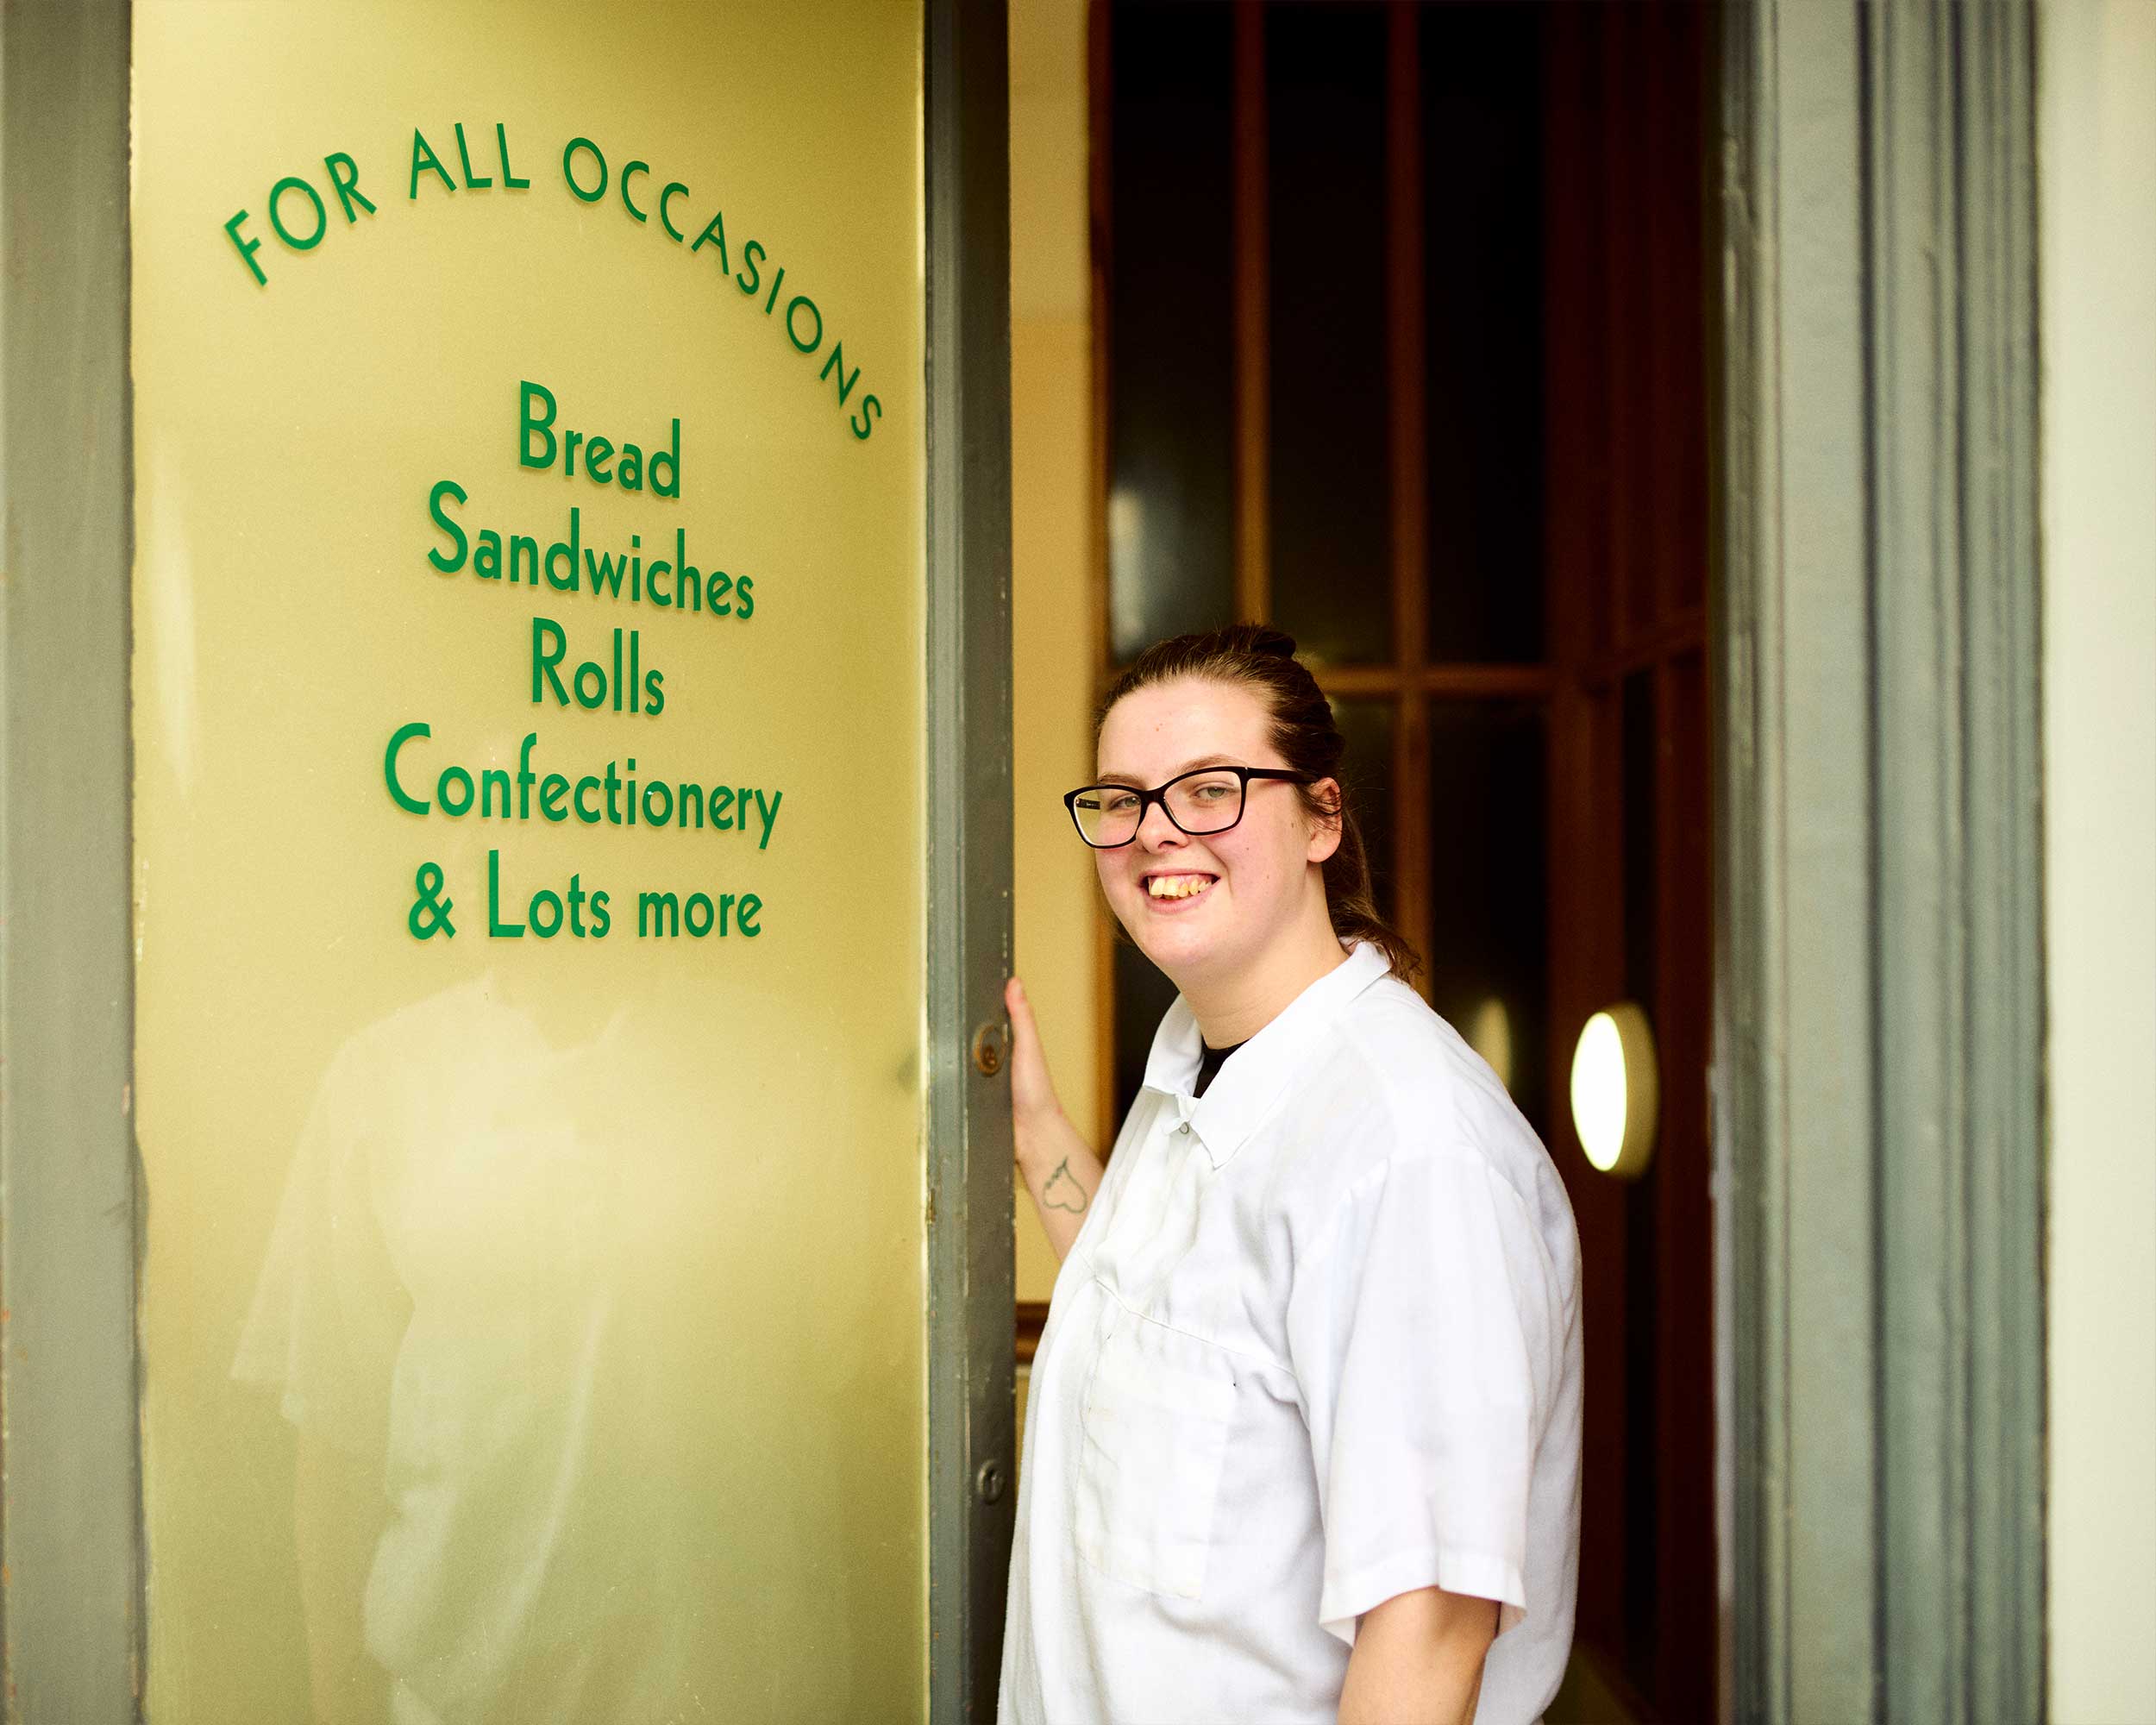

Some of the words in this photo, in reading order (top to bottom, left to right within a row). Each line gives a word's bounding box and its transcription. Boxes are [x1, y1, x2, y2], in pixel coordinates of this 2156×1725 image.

[223, 151, 378, 287] FOR
[408, 122, 531, 201] ALL
[562, 137, 882, 442] OCCASIONS
[518, 379, 681, 499] Bread
[427, 479, 755, 620] Sandwiches
[531, 616, 665, 717] Rolls
[383, 721, 783, 850] Confectionery
[407, 861, 457, 941] &
[487, 848, 611, 939] Lots
[637, 891, 763, 938] more
